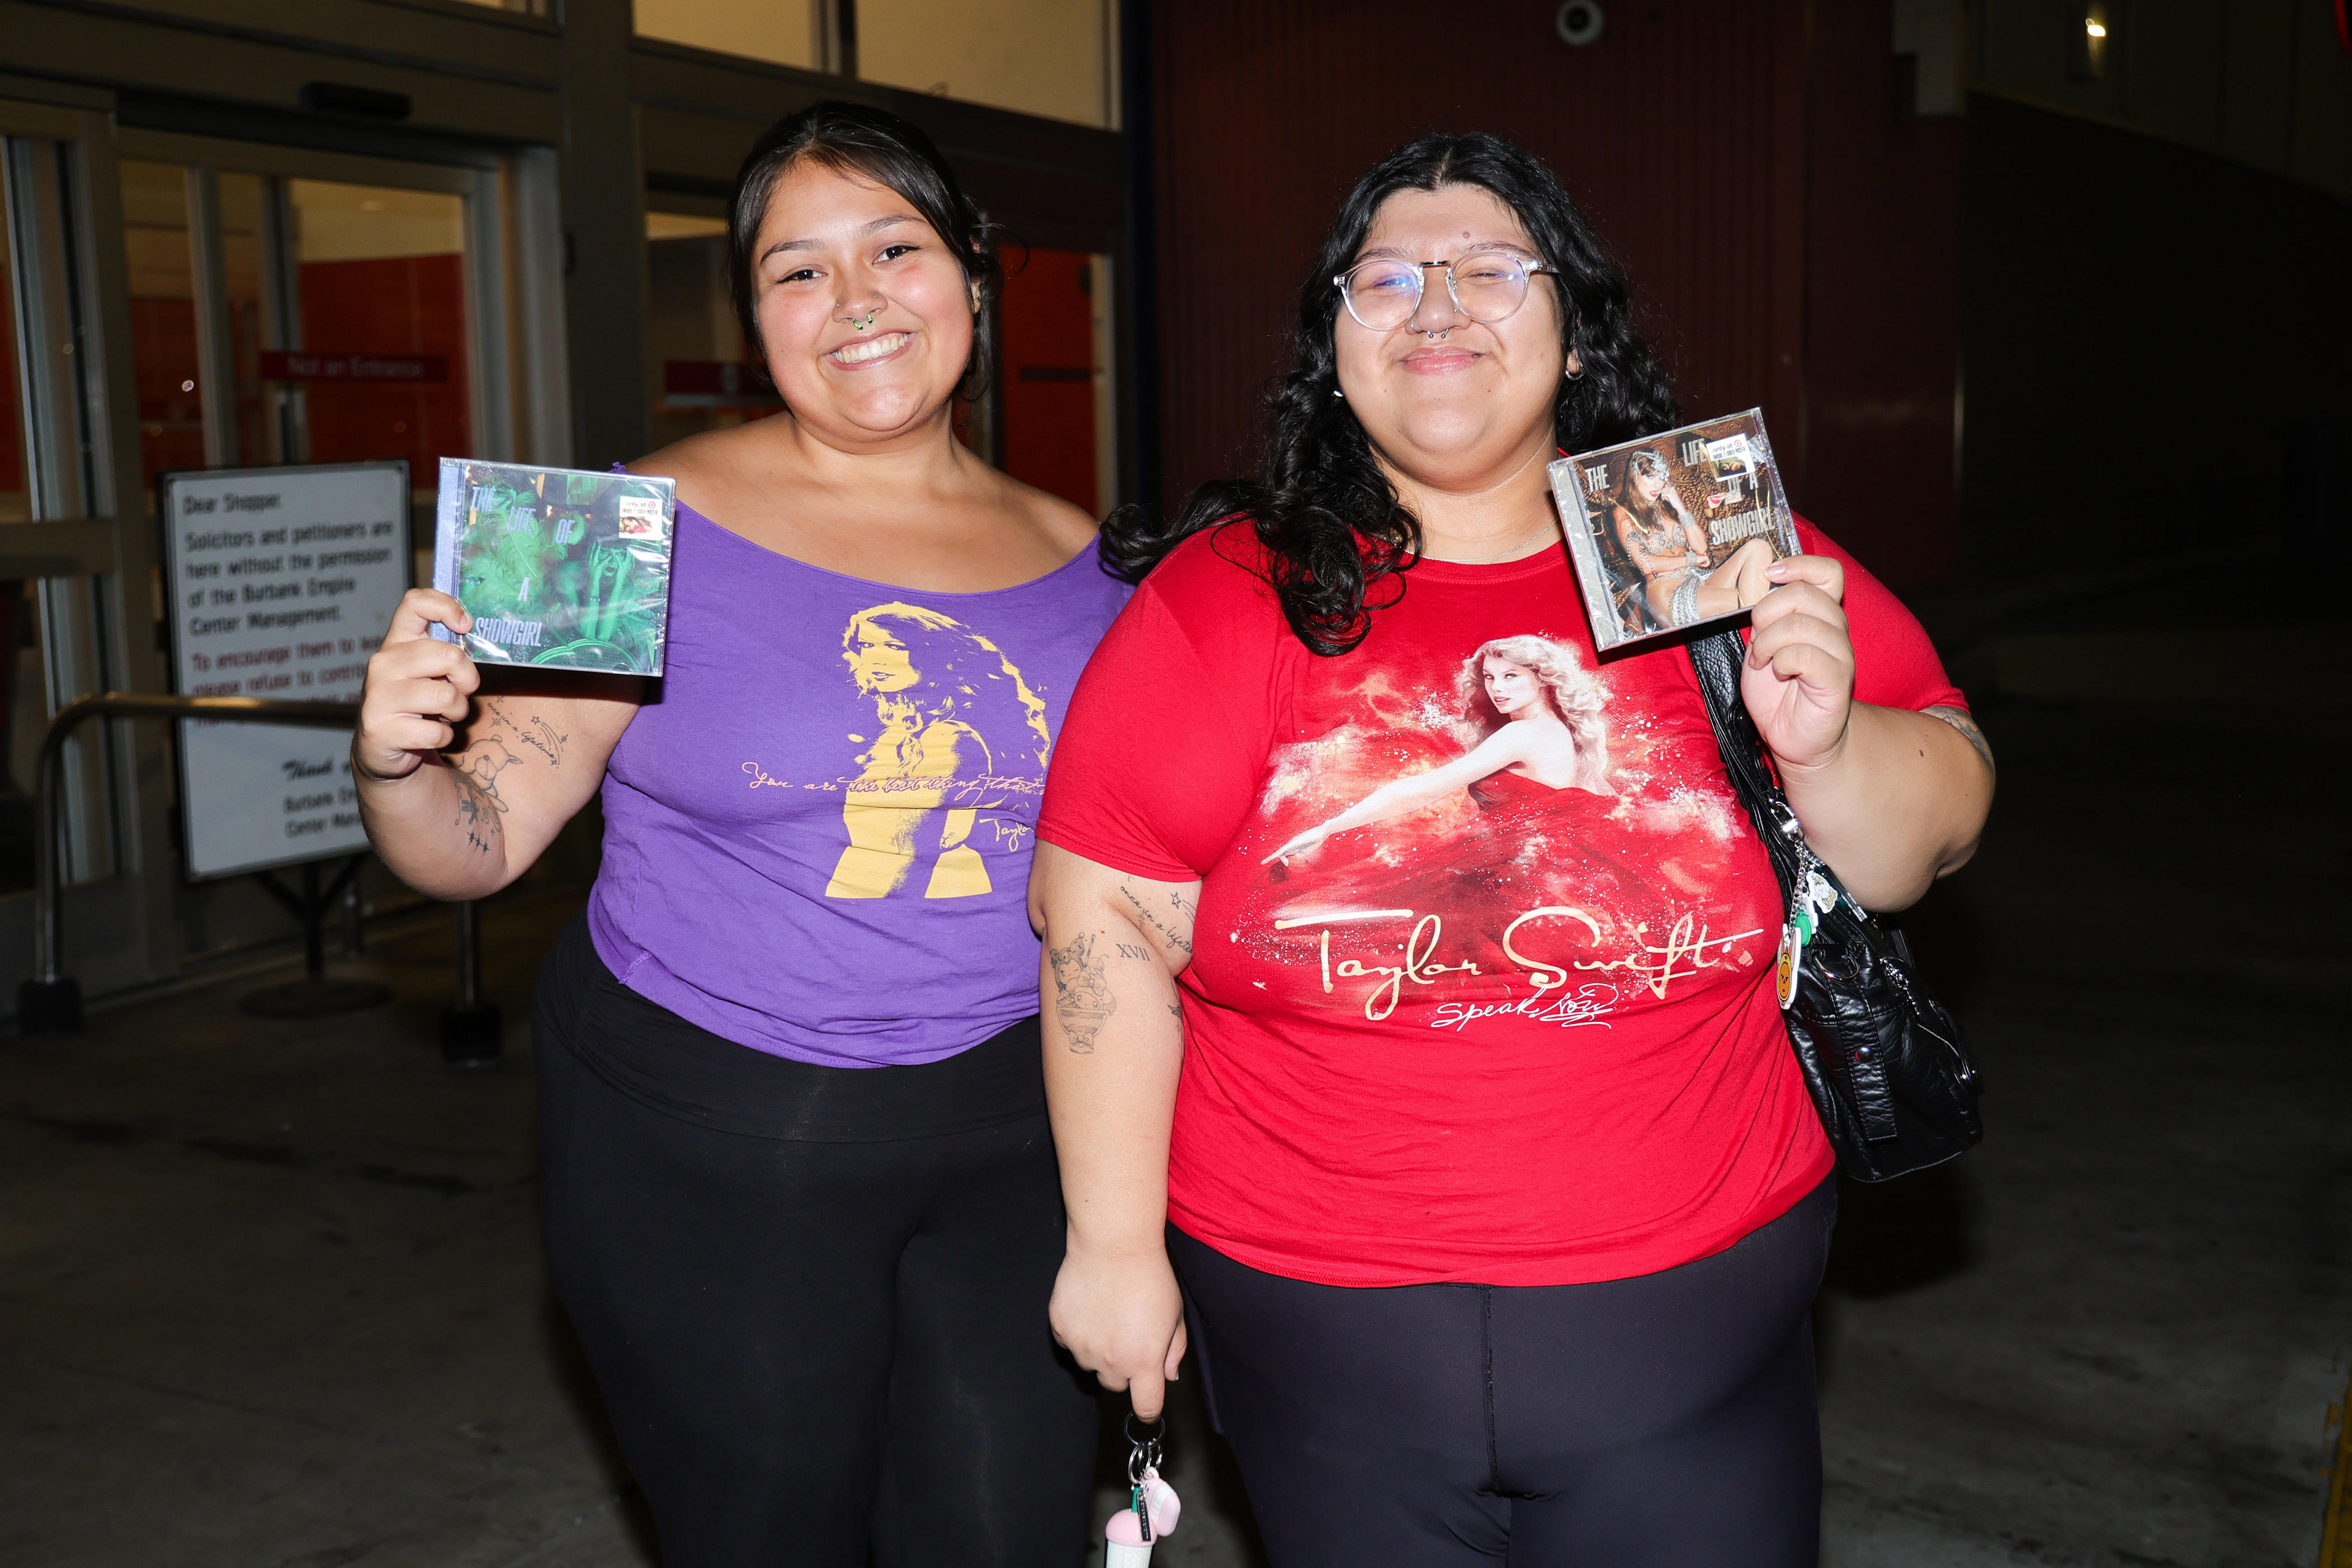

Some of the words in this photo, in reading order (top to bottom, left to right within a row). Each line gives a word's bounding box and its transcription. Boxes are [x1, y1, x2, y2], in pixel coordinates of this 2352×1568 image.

[287, 356, 319, 376] Not
[325, 359, 344, 376] an
[349, 355, 424, 378] Entrance
[1682, 438, 1707, 467] LIFE
[1585, 464, 1610, 492] THE
[1727, 476, 1742, 495] OF
[1749, 472, 1759, 490] A
[182, 494, 216, 514] Dear
[472, 486, 496, 513] THE
[507, 507, 536, 533] LIFE
[555, 519, 575, 544] OF
[1710, 507, 1775, 545] SHOWGIRL
[185, 530, 254, 552] Solicitors
[259, 526, 289, 545] and
[292, 522, 366, 546] petitioners
[370, 521, 393, 537] are
[186, 563, 221, 580] here
[226, 557, 284, 575] without
[289, 554, 312, 570] the
[317, 548, 391, 570] permission
[187, 588, 205, 608] of
[211, 587, 237, 605] the
[242, 582, 302, 604] Burbank
[307, 577, 356, 597] Empire
[518, 577, 530, 602] A
[189, 616, 240, 636] Center
[474, 617, 541, 647] SHOWGIRL
[192, 651, 211, 670] To
[216, 644, 290, 667] encourage
[296, 639, 334, 658] them
[339, 637, 355, 654] to
[191, 679, 241, 697] please
[245, 672, 292, 692] refuse
[296, 669, 315, 687] to
[521, 731, 556, 758] lifetime
[282, 756, 334, 779] Thank
[742, 762, 794, 788] You
[803, 782, 838, 791] are
[837, 777, 879, 792] the
[882, 777, 920, 793] best
[920, 775, 984, 807] thing
[284, 791, 334, 813] Burbank
[284, 818, 328, 838] Center
[1120, 886, 1142, 909] once
[1116, 943, 1151, 962] XVII
[1274, 909, 1481, 1021] Taylor
[1502, 905, 1765, 1000] Swift
[1430, 984, 1548, 1032] Speak
[1529, 983, 1619, 1029] Now
